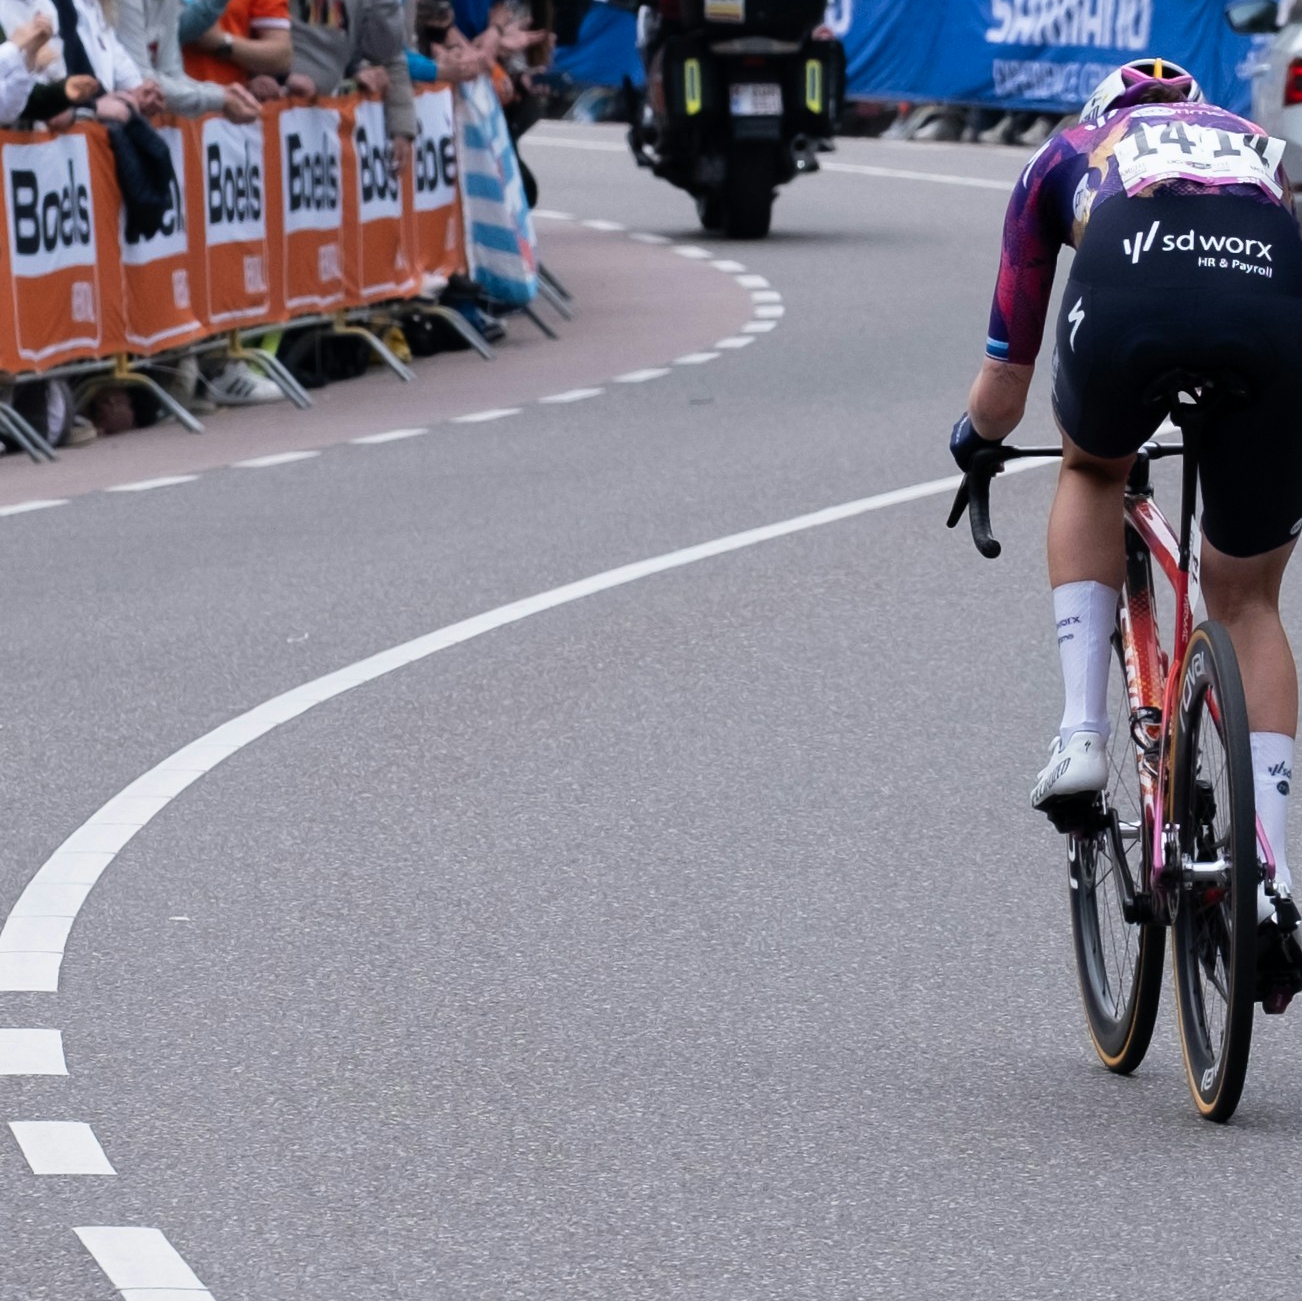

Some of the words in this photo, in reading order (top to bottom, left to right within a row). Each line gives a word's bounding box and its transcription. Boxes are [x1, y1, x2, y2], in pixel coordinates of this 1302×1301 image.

[11, 157, 90, 256] Boels
[208, 138, 260, 225] Boels
[1162, 229, 1195, 251] sd
[1199, 235, 1273, 261] worx
[1198, 257, 1216, 268] HR
[1219, 258, 1229, 268] &
[1231, 259, 1273, 279] Payroll
